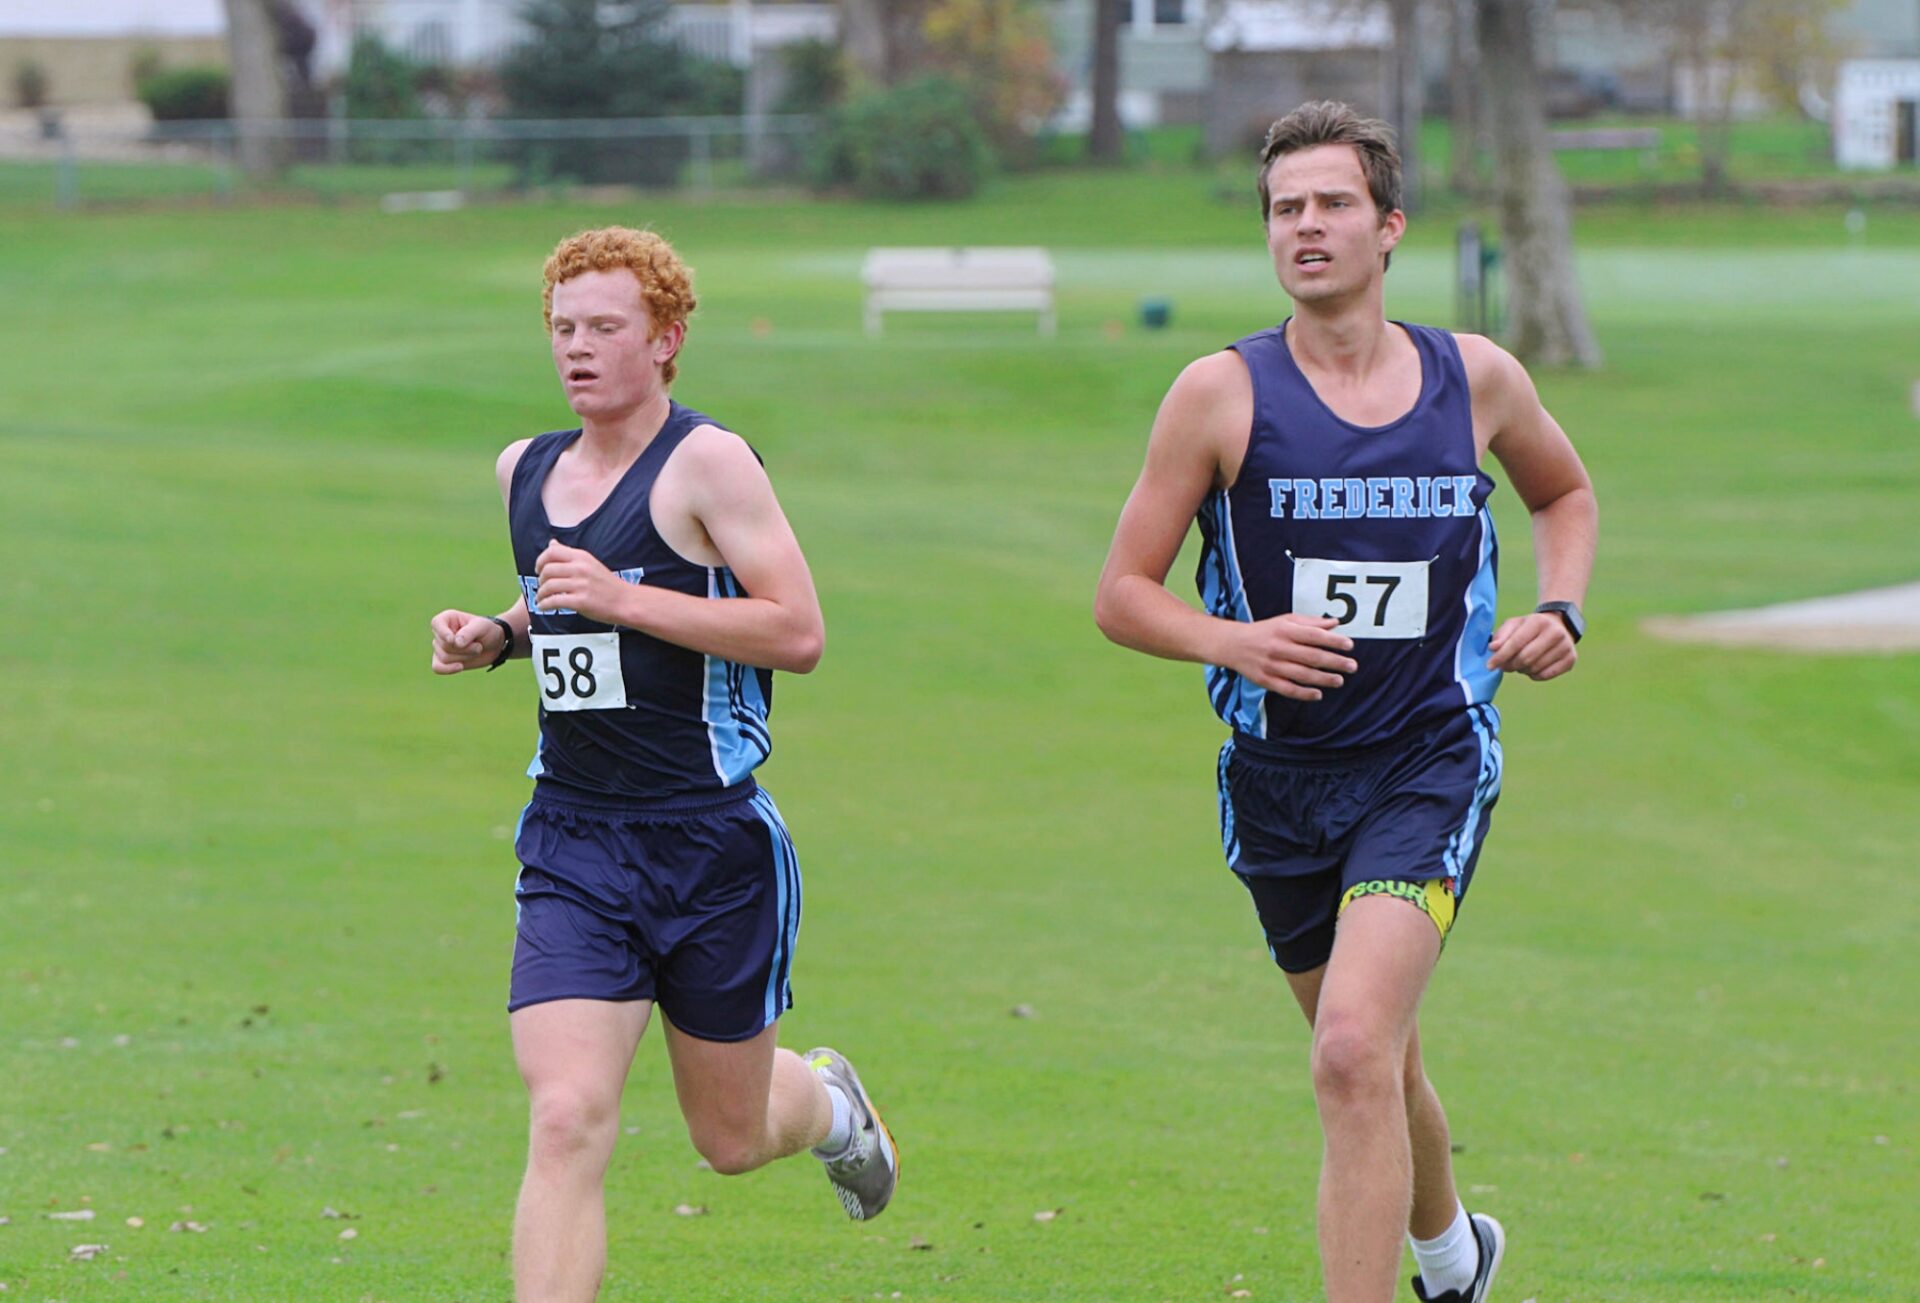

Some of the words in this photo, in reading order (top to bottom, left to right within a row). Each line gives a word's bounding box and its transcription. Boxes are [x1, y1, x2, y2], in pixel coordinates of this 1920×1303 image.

[1268, 475, 1477, 519] FREDERICK
[1322, 574, 1402, 626] 57
[542, 646, 597, 700] 58
[1352, 879, 1429, 912] SOUR
